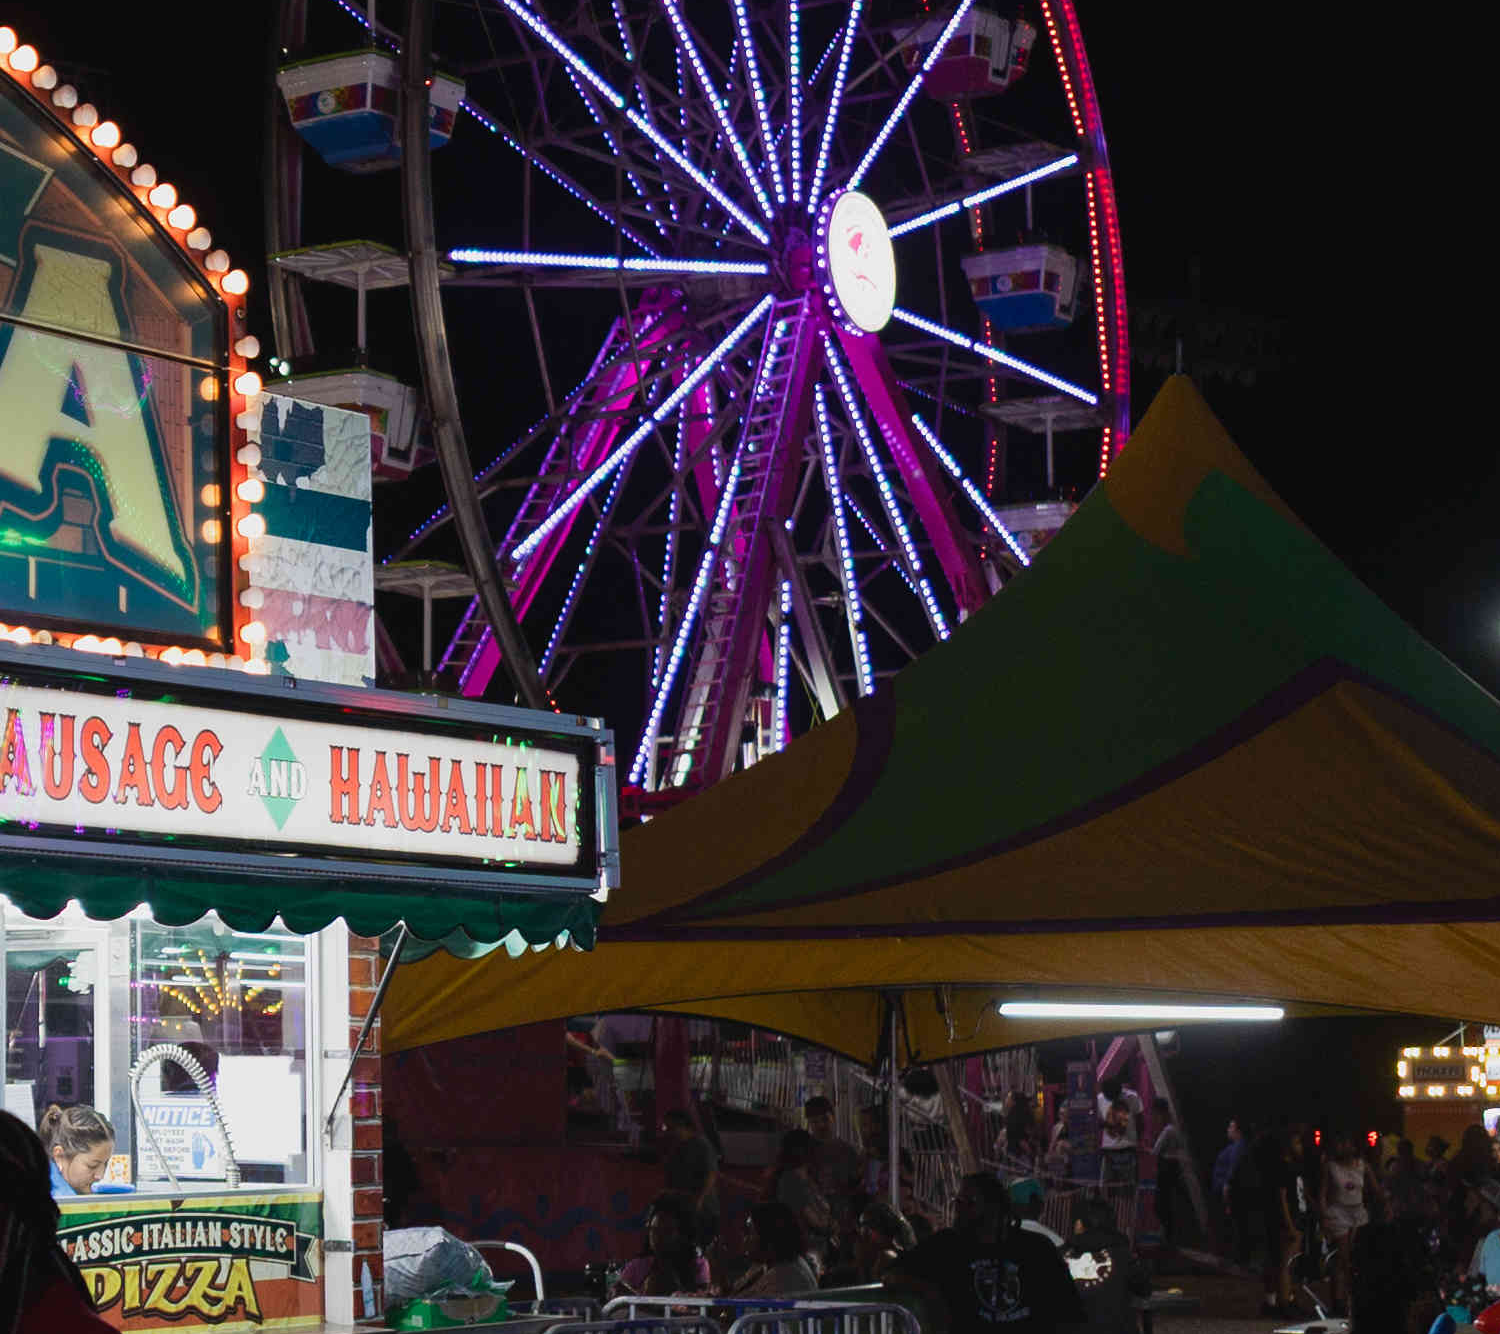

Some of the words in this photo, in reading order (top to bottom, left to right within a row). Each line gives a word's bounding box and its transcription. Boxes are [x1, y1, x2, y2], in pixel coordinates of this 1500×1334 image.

[247, 755, 308, 802] AND
[328, 744, 569, 845] HAWAIIAN
[142, 1106, 215, 1126] NOTICE
[142, 1221, 222, 1251] ITALIAN
[228, 1221, 288, 1252] STYLE
[80, 1258, 262, 1320] PIZZA
